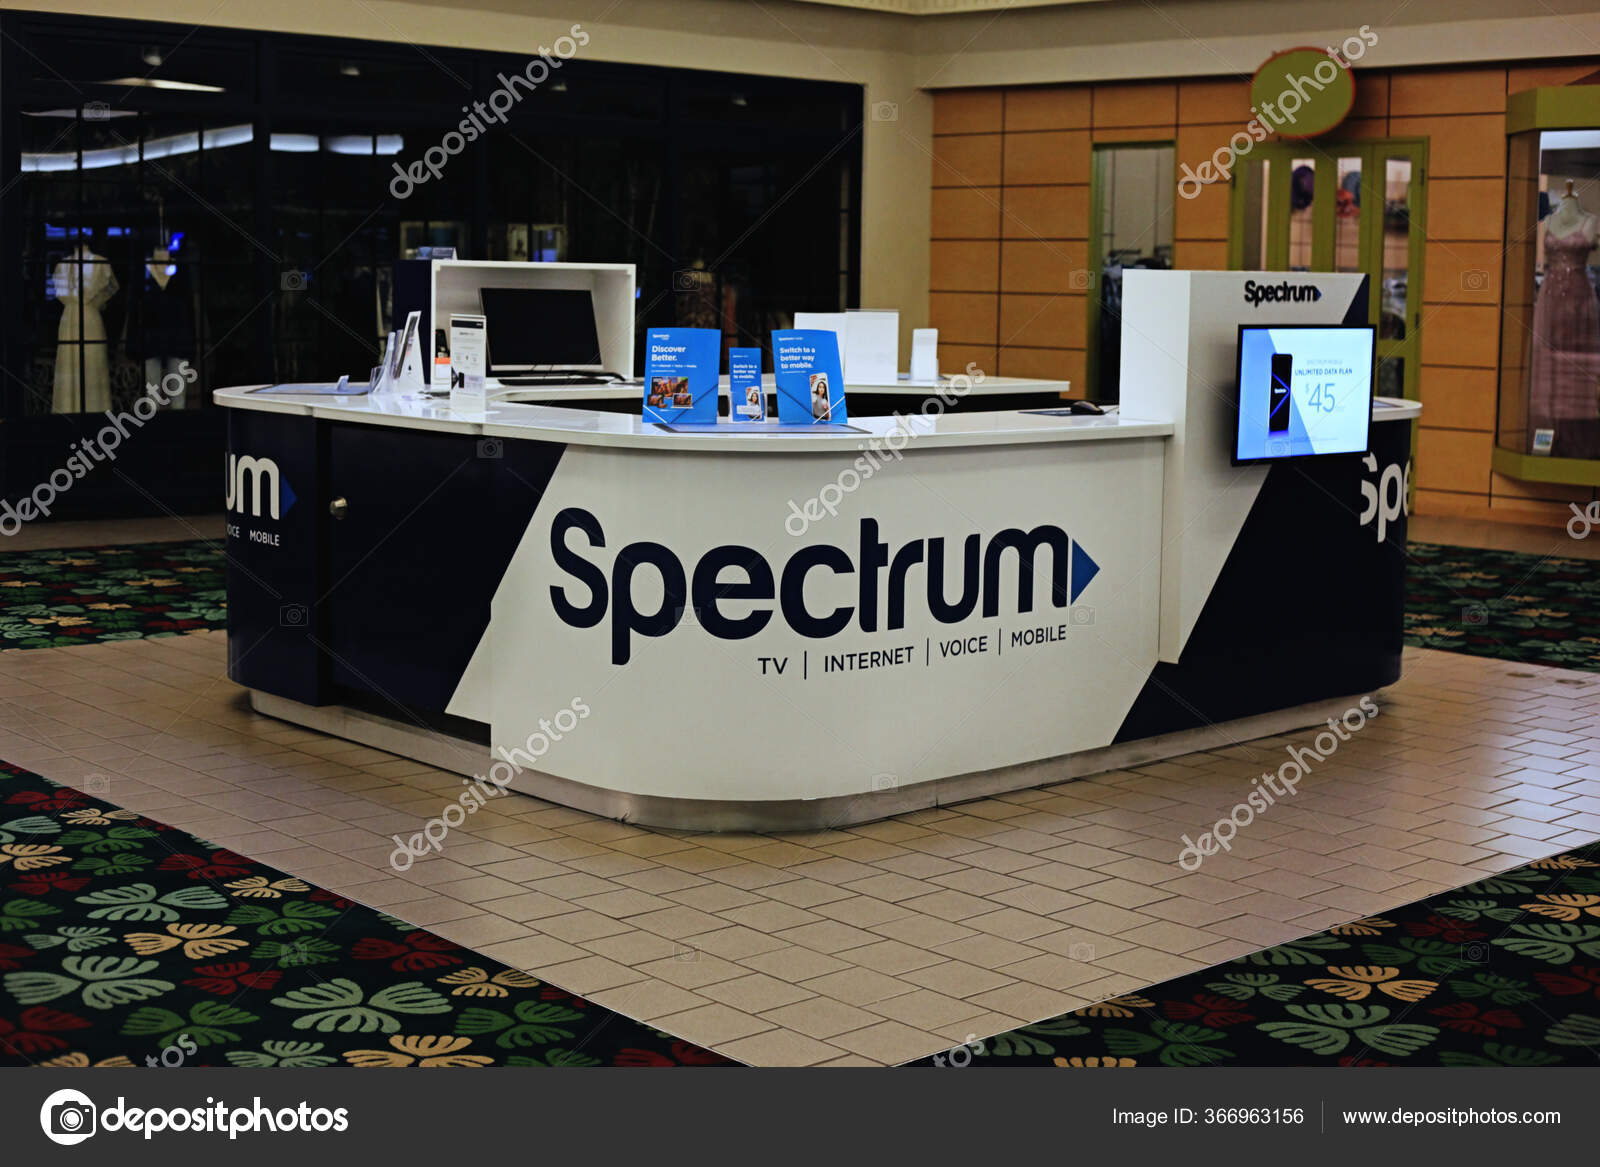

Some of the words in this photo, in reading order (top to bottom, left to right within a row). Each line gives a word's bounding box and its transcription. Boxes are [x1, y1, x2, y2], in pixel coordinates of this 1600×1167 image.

[1244, 280, 1318, 308] Spectrum
[651, 345, 686, 353] Discover
[1295, 367, 1323, 376] UNLIMITED
[1324, 367, 1337, 375] DATA
[1339, 367, 1353, 375] PLAN
[249, 529, 280, 547] MOBILE
[549, 508, 1069, 666] Spectrum
[757, 657, 788, 675] TV
[824, 646, 914, 673] INTERNET
[939, 635, 988, 658] VOICE
[1011, 624, 1067, 648] MOBILE
